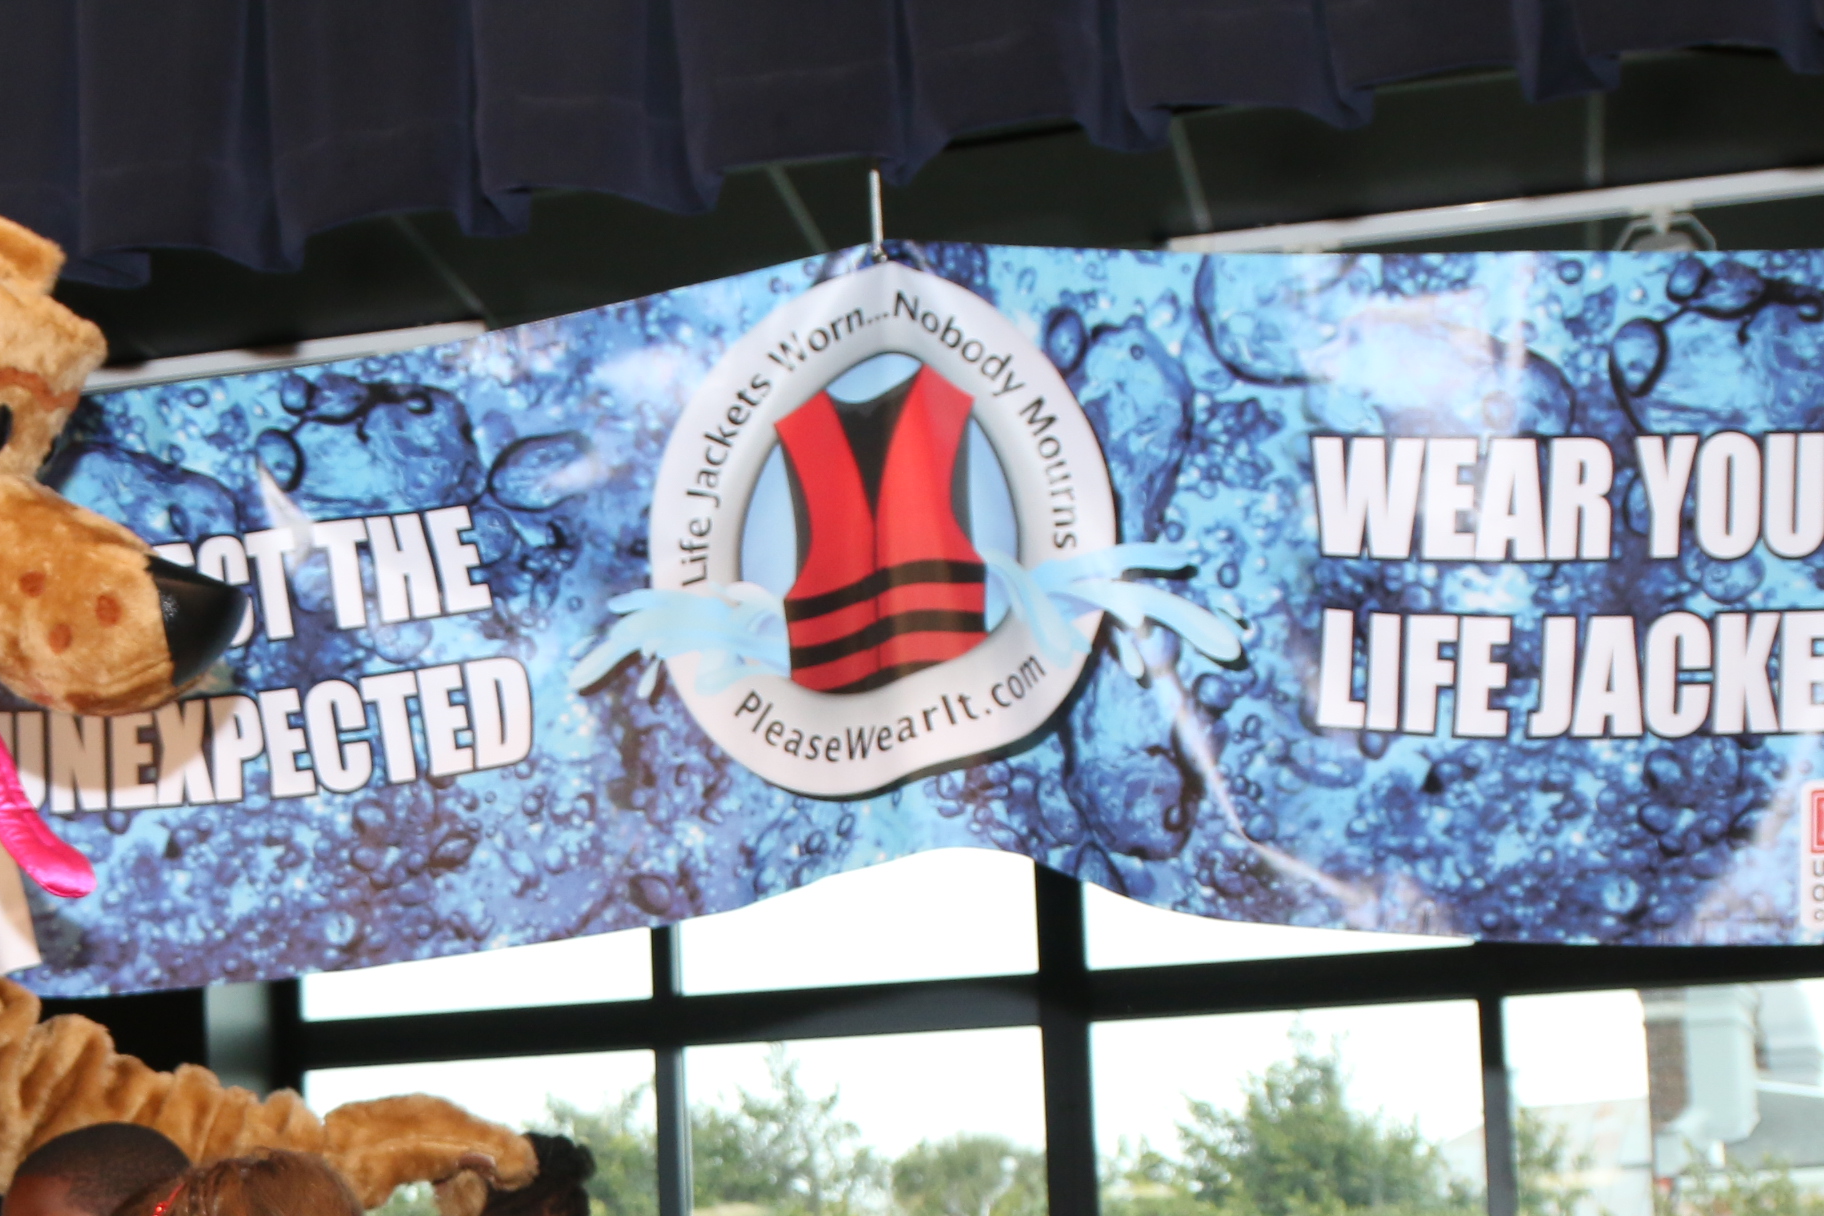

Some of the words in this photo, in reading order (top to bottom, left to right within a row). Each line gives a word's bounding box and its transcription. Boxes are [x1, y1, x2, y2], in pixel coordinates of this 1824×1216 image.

[685, 373, 771, 508] Jackets
[1017, 396, 1077, 550] Mourns
[1310, 435, 1614, 561] WEAR
[314, 504, 493, 630] THE
[679, 518, 712, 588] Life
[733, 654, 1048, 763] PleaseWearIt.com
[1315, 607, 1512, 738] LIFE
